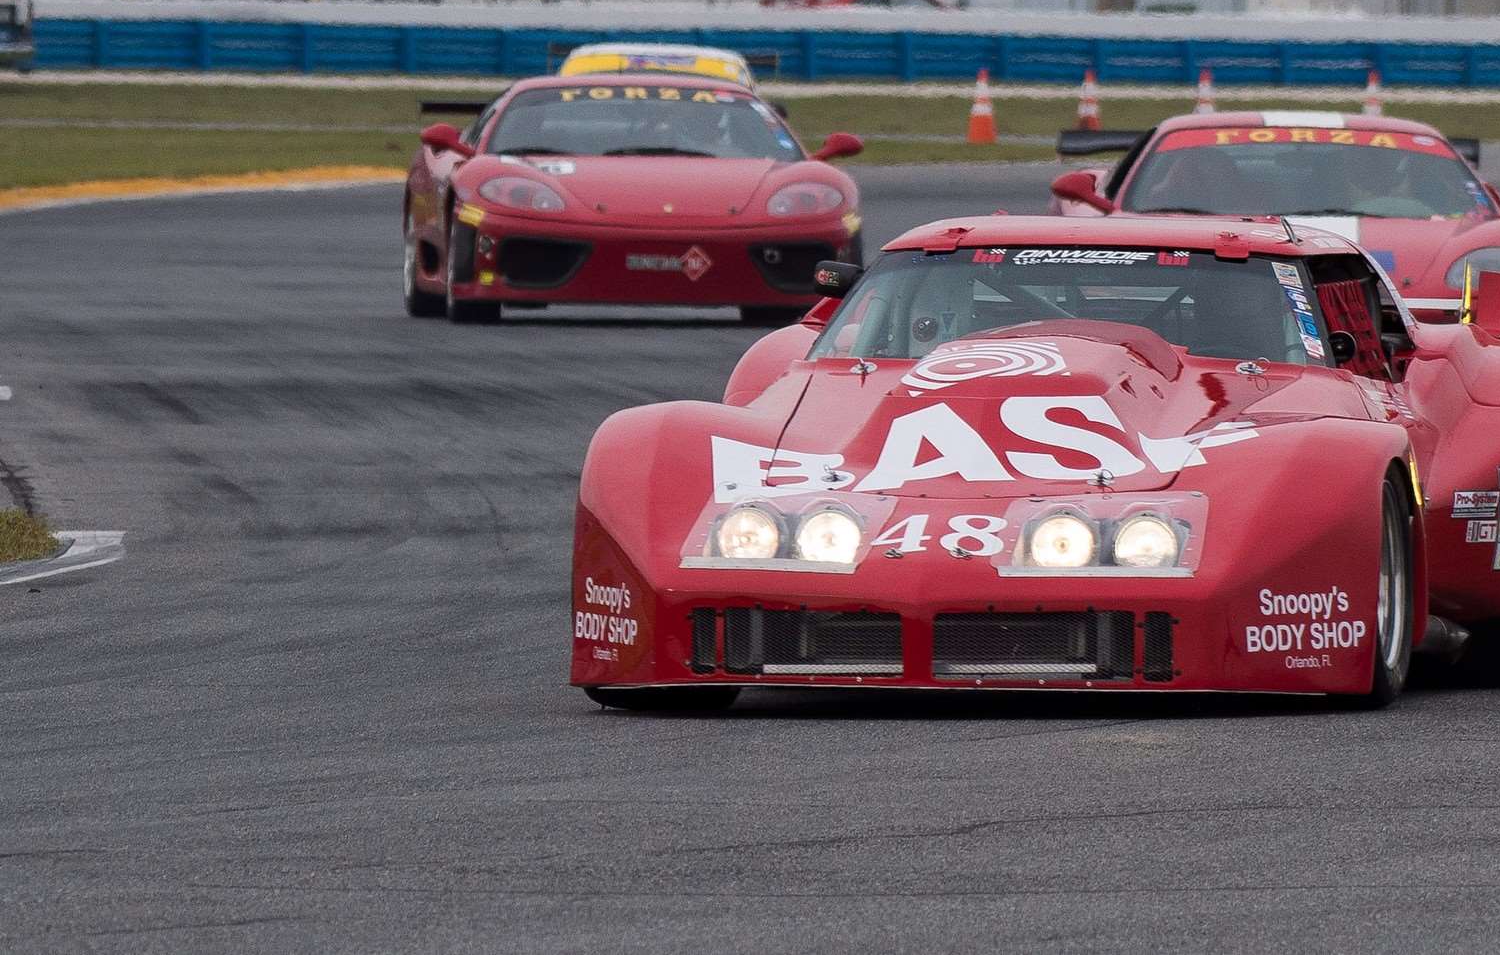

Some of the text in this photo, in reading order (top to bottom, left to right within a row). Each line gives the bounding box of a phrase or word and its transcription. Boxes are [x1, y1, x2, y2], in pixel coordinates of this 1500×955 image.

[1215, 128, 1398, 149] FORZA
[1015, 249, 1155, 261] DINWIDDIE
[1042, 257, 1137, 265] MOTORSPORTS
[711, 395, 1260, 503] BASF
[1456, 492, 1498, 506] Pro-System
[871, 514, 1008, 556] 48
[1480, 523, 1498, 539] GT
[585, 576, 631, 614] Snoopy's
[1259, 586, 1349, 620] Snoopy's
[575, 611, 638, 645] BODY SHOP
[1246, 620, 1366, 652] BODY SHOP
